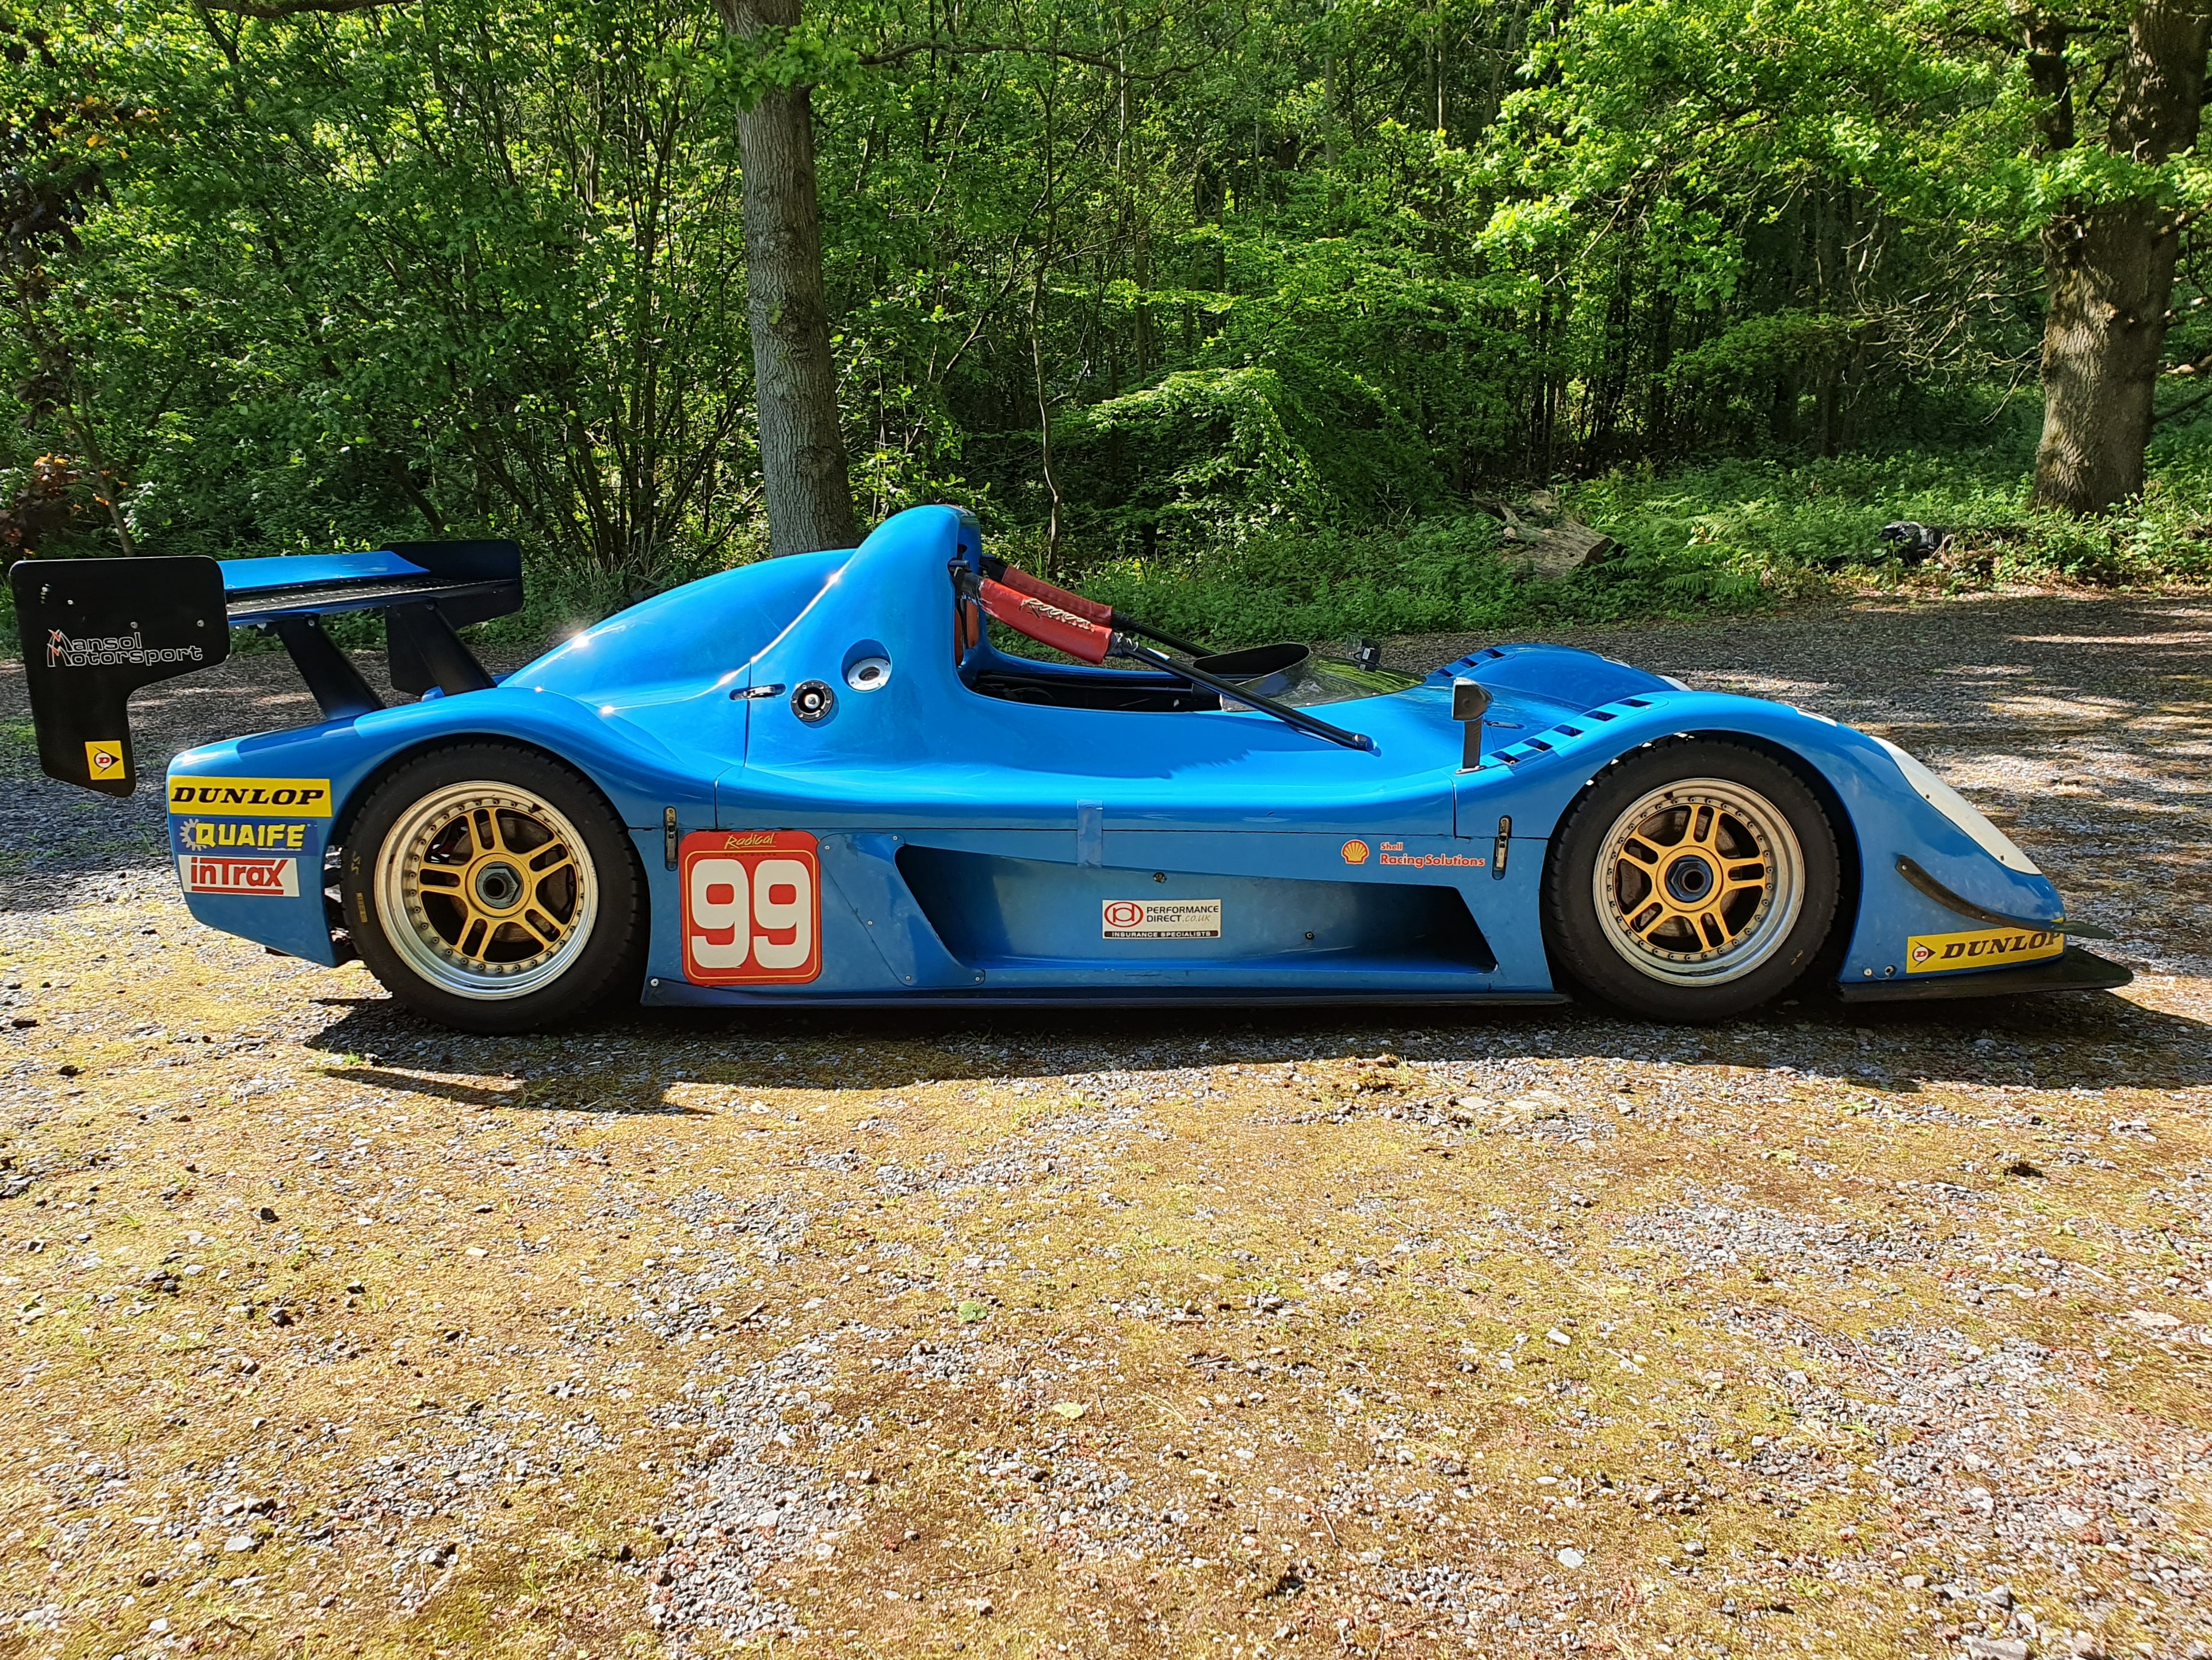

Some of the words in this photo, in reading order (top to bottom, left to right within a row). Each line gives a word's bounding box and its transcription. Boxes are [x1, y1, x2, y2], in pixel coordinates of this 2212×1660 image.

[47, 629, 142, 652] Mansol
[47, 643, 203, 667] Motorsport
[171, 787, 324, 805] DUNLOP
[195, 822, 306, 848] QUAIFE
[724, 833, 775, 849] Radical
[1380, 842, 1403, 850] Shell
[1380, 854, 1424, 868] Racing
[1425, 854, 1485, 867] Solutions
[691, 858, 811, 969] 99
[1147, 906, 1219, 914] PERFORMANCE
[1940, 932, 2061, 959] DUNLOP
